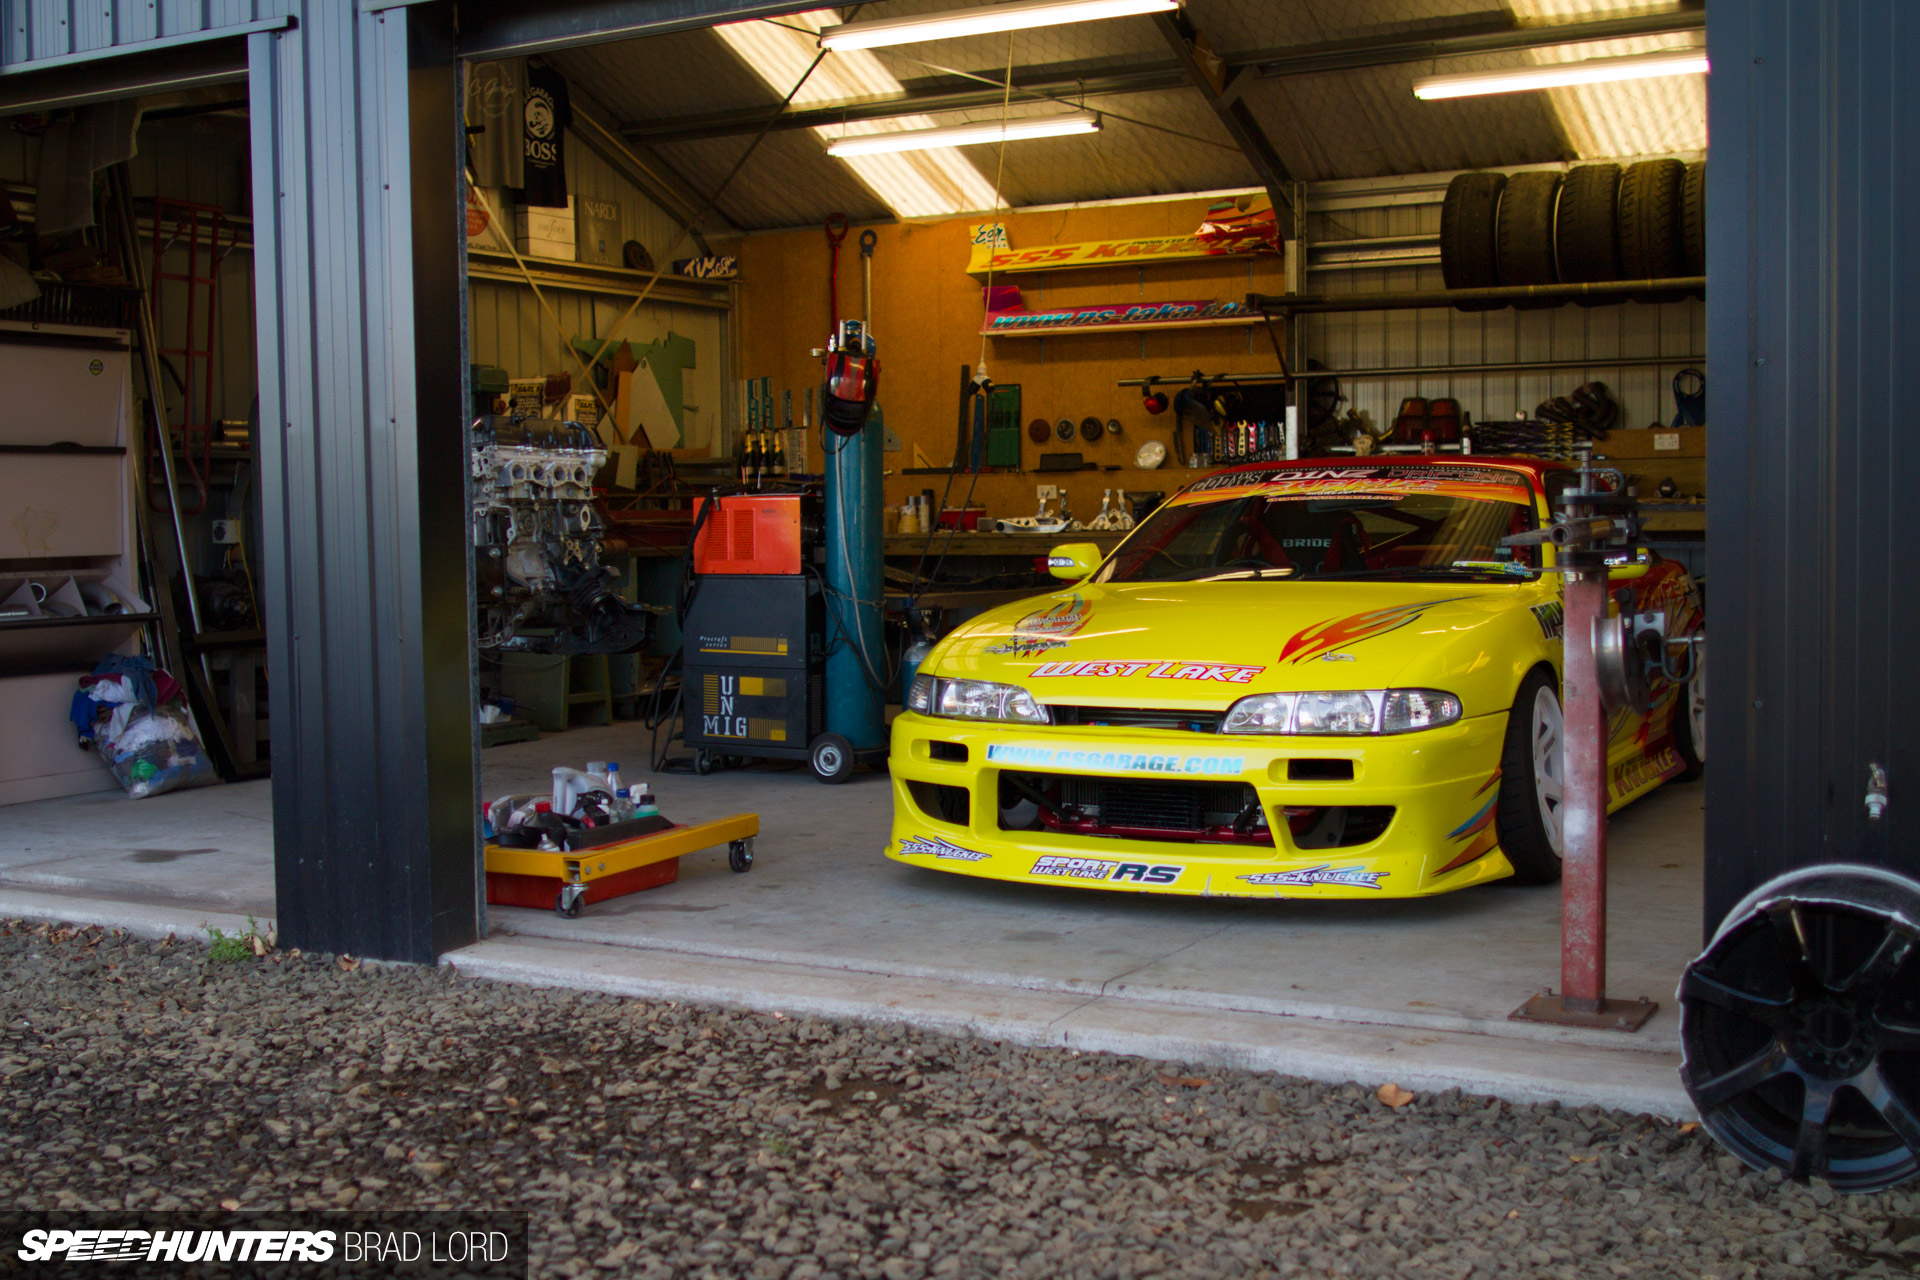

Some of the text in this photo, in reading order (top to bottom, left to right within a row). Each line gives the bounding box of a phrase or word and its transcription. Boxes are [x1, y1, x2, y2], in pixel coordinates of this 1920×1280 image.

[524, 138, 558, 161] BOSS
[584, 201, 617, 221] NARDI
[980, 247, 1080, 269] 555
[1282, 538, 1332, 548] BRIDE
[1028, 660, 1267, 684] WEST LAKE
[703, 715, 747, 736] MIG
[986, 744, 1246, 775] WWW.CSGARAGE.COM
[1030, 866, 1110, 880] WEST LAKE
[1036, 855, 1119, 871] SPORT
[1108, 861, 1186, 886] RS
